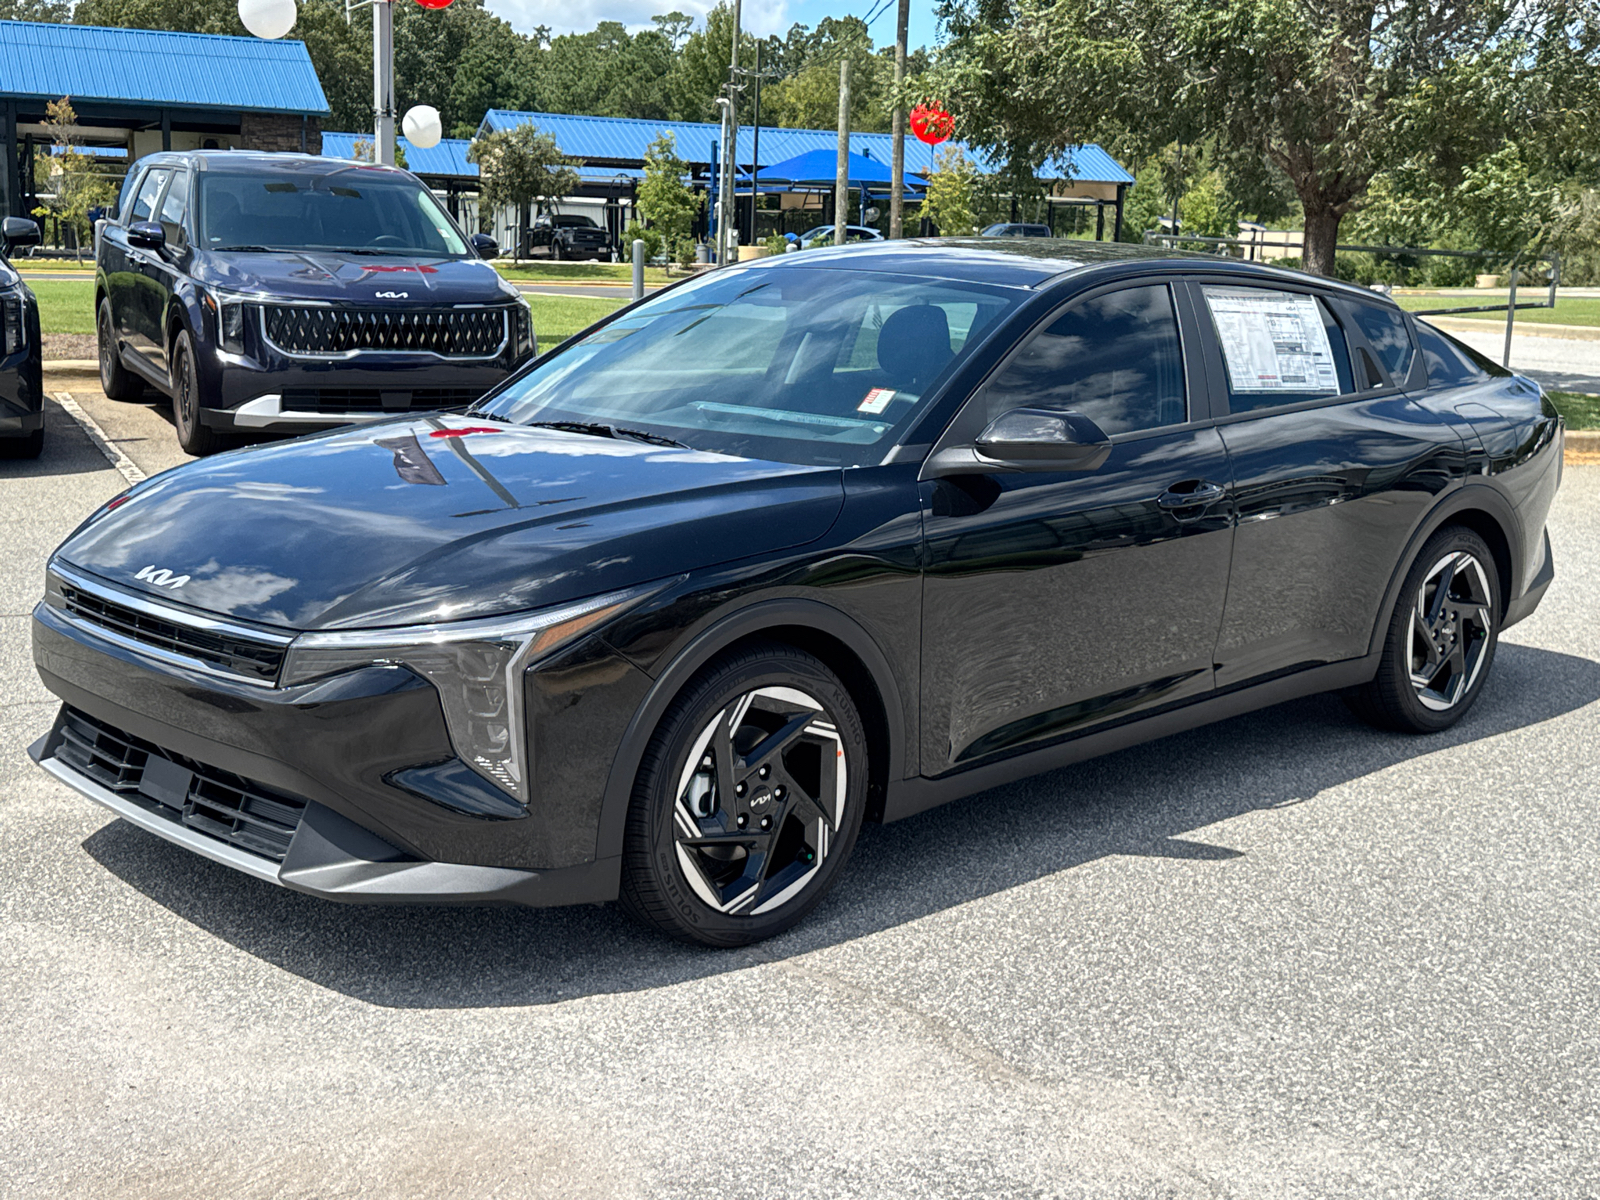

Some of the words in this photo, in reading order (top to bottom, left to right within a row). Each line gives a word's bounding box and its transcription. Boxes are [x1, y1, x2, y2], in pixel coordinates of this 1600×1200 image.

[135, 565, 190, 590] KIA
[833, 688, 861, 746] KUMHO
[663, 873, 701, 924] SOLUS
